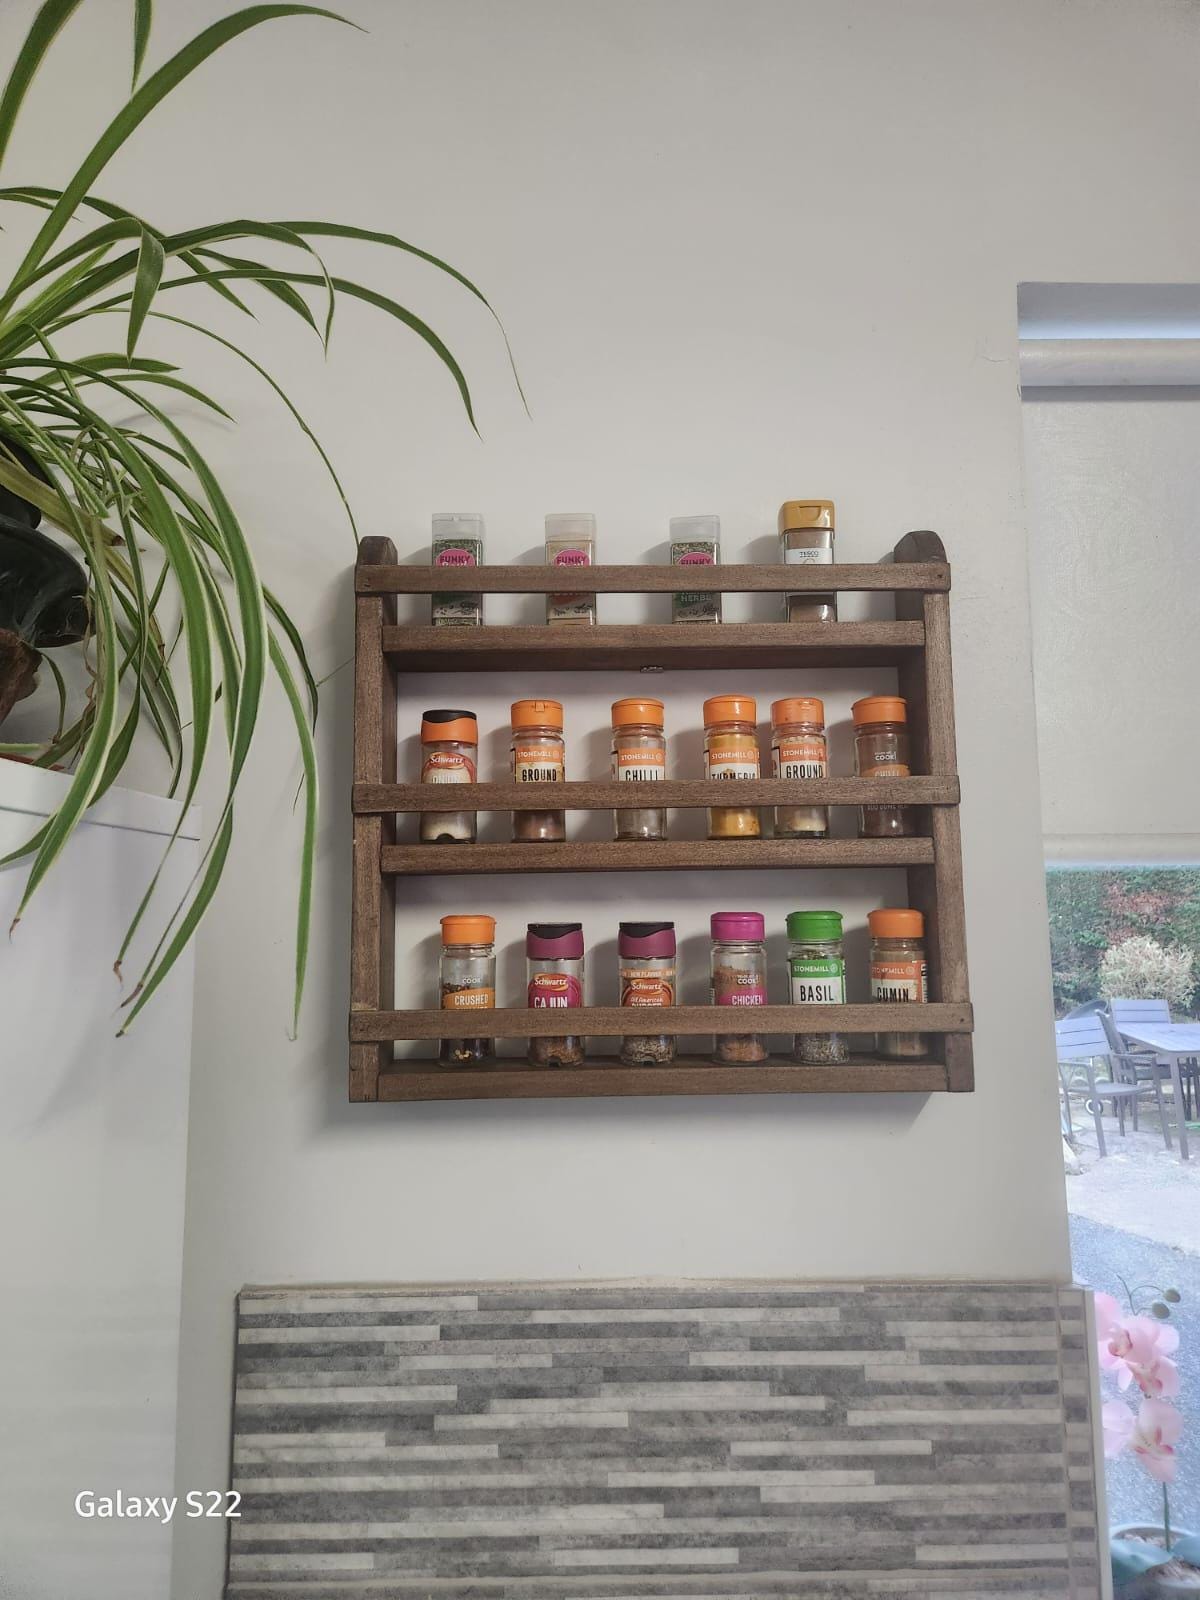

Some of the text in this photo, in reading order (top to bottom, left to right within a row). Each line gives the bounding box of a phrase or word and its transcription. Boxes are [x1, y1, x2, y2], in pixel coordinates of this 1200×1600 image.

[799, 550, 819, 558] TESCO
[439, 555, 471, 564] FUNKY
[556, 555, 587, 564] FUNKY
[517, 750, 552, 759] STONEMILL
[621, 753, 655, 762] STONEMILL
[711, 751, 747, 760] STONEMILL
[782, 749, 818, 758] STONEMILL
[430, 756, 464, 764] Schwartz
[522, 768, 557, 782] GROUND
[625, 769, 659, 781] CHILLI
[786, 764, 823, 779] GROUND
[794, 964, 829, 973] STONEMILL
[534, 977, 568, 986] Schwartz
[631, 982, 663, 990] Schwartz
[800, 985, 834, 1001] BASIL
[877, 986, 909, 1003] CUMIN
[454, 994, 489, 1006] CRUSHED
[731, 995, 763, 1006] CHICKEN
